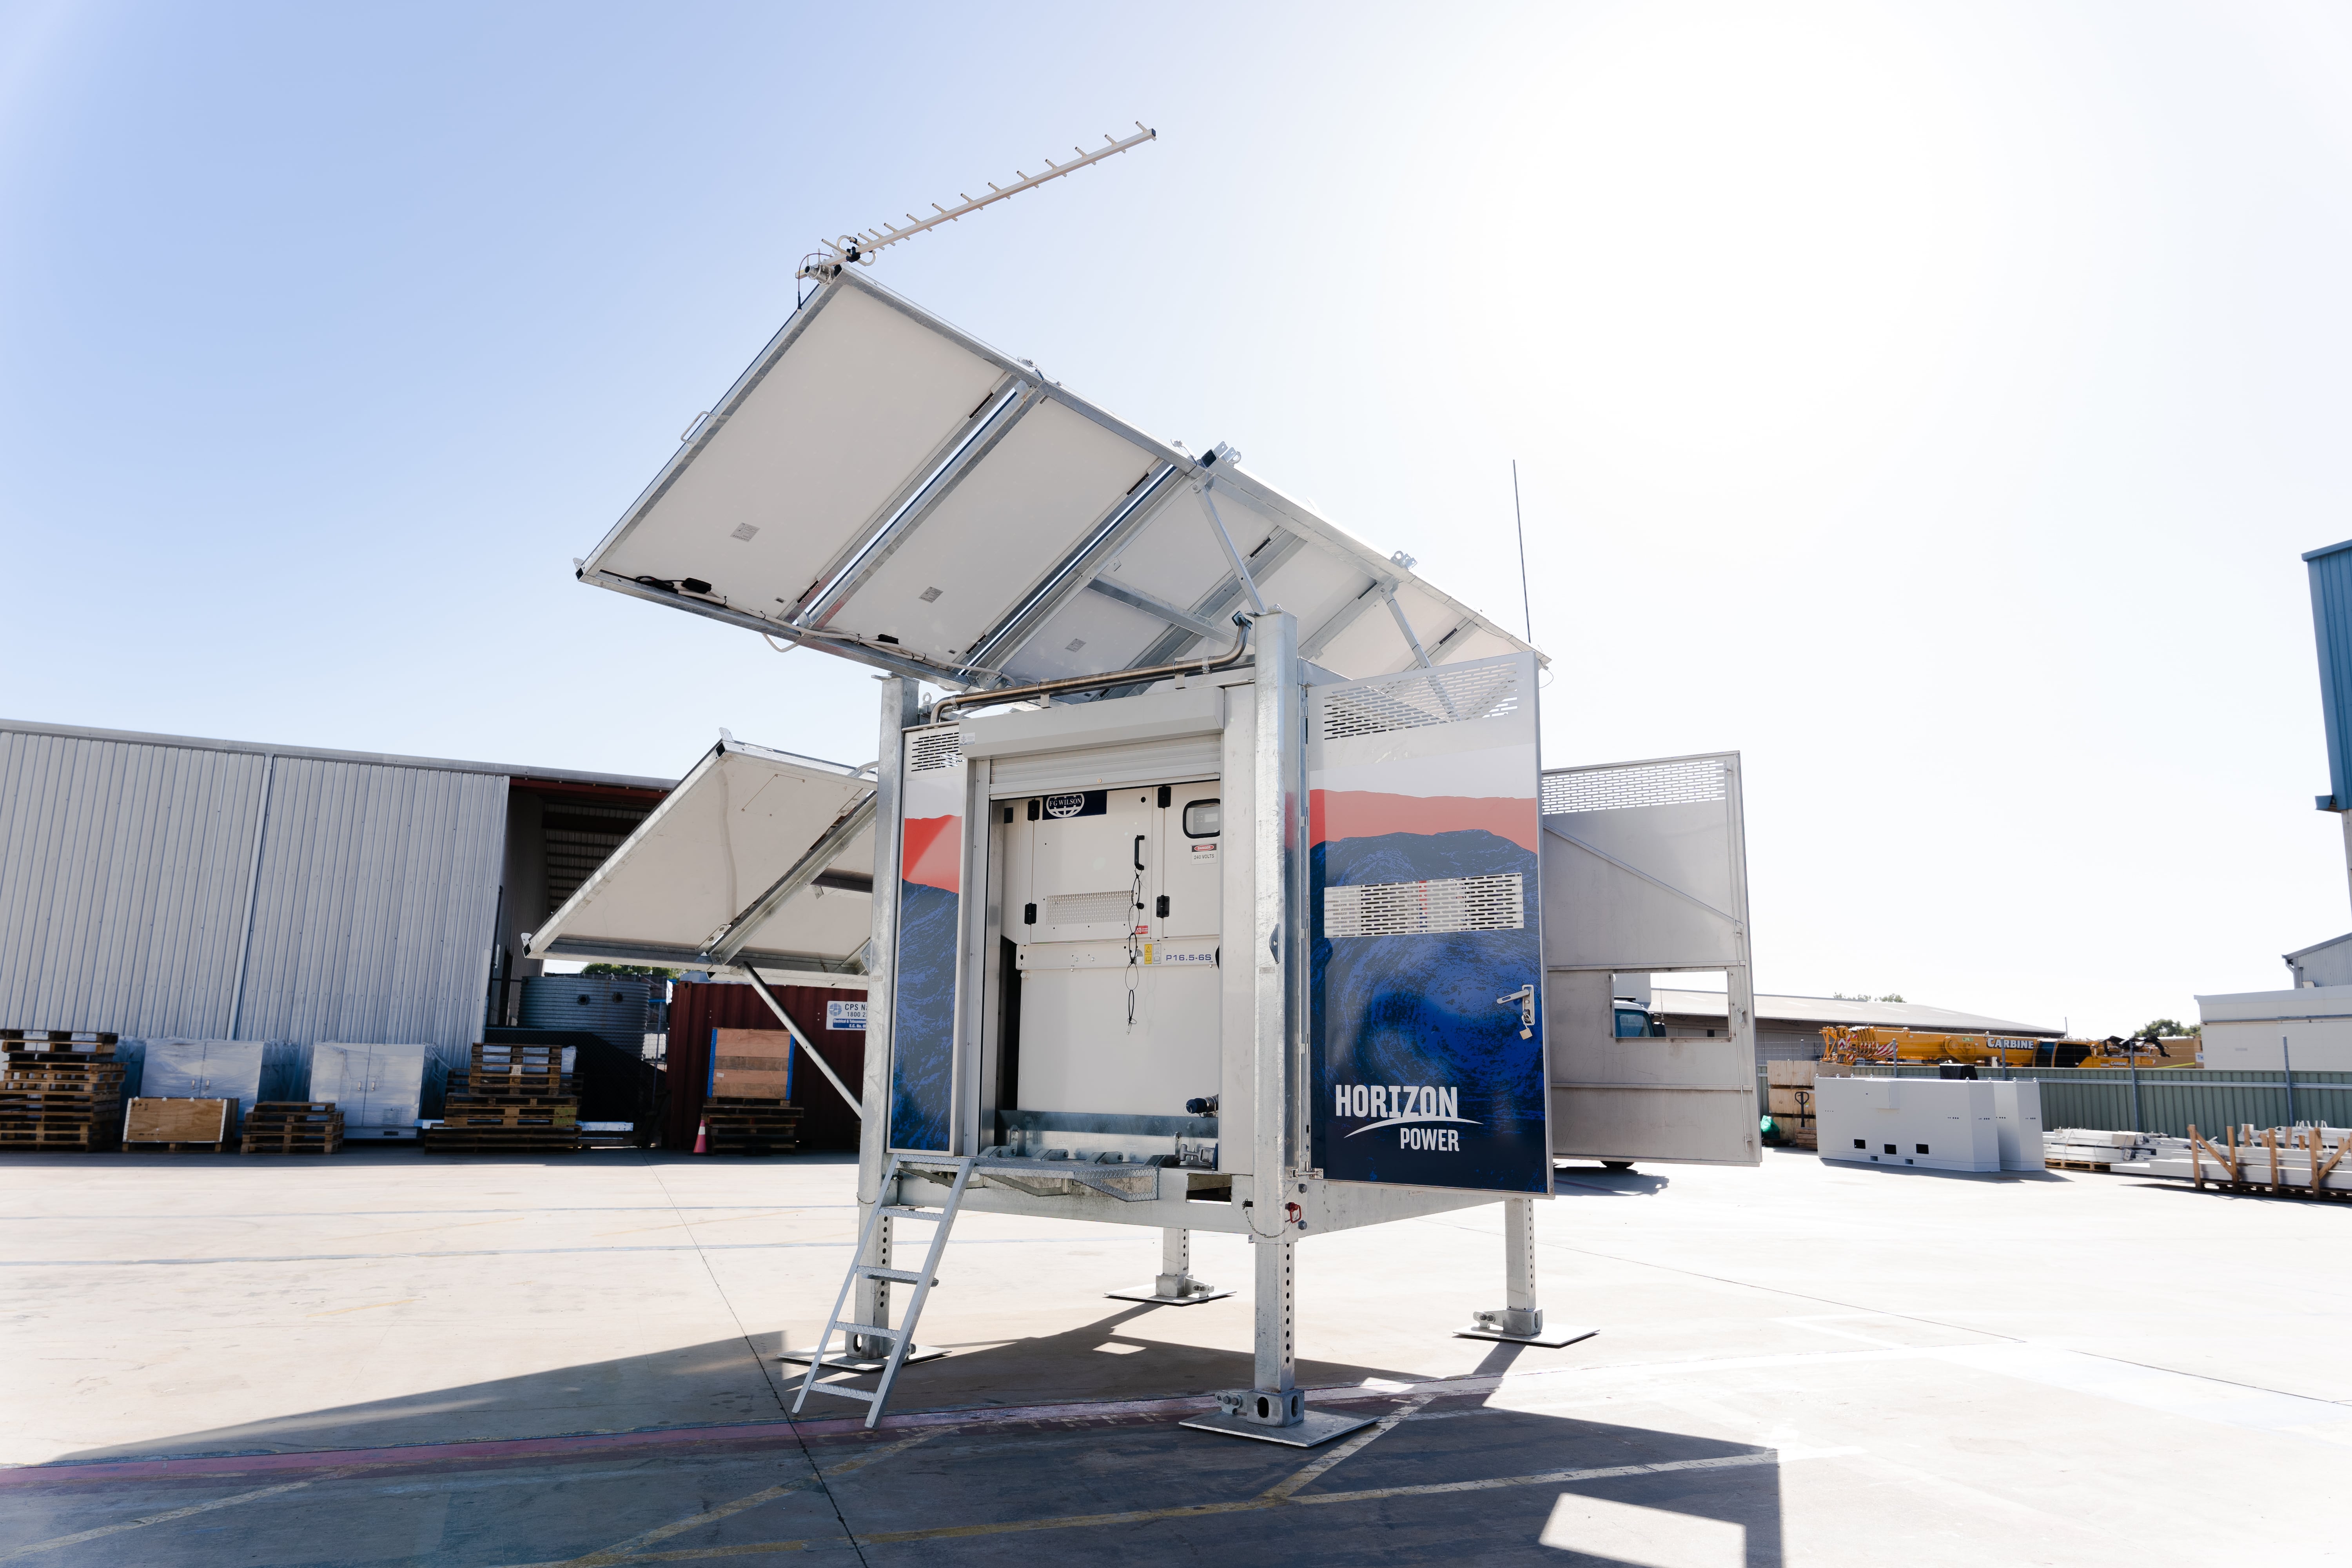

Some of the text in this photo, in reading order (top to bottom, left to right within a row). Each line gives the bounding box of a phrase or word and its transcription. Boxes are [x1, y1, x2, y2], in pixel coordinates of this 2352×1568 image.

[1987, 1038, 2034, 1049] CARBINE
[1336, 1085, 1458, 1118] HORIZON
[1401, 1128, 1459, 1152] POWER
